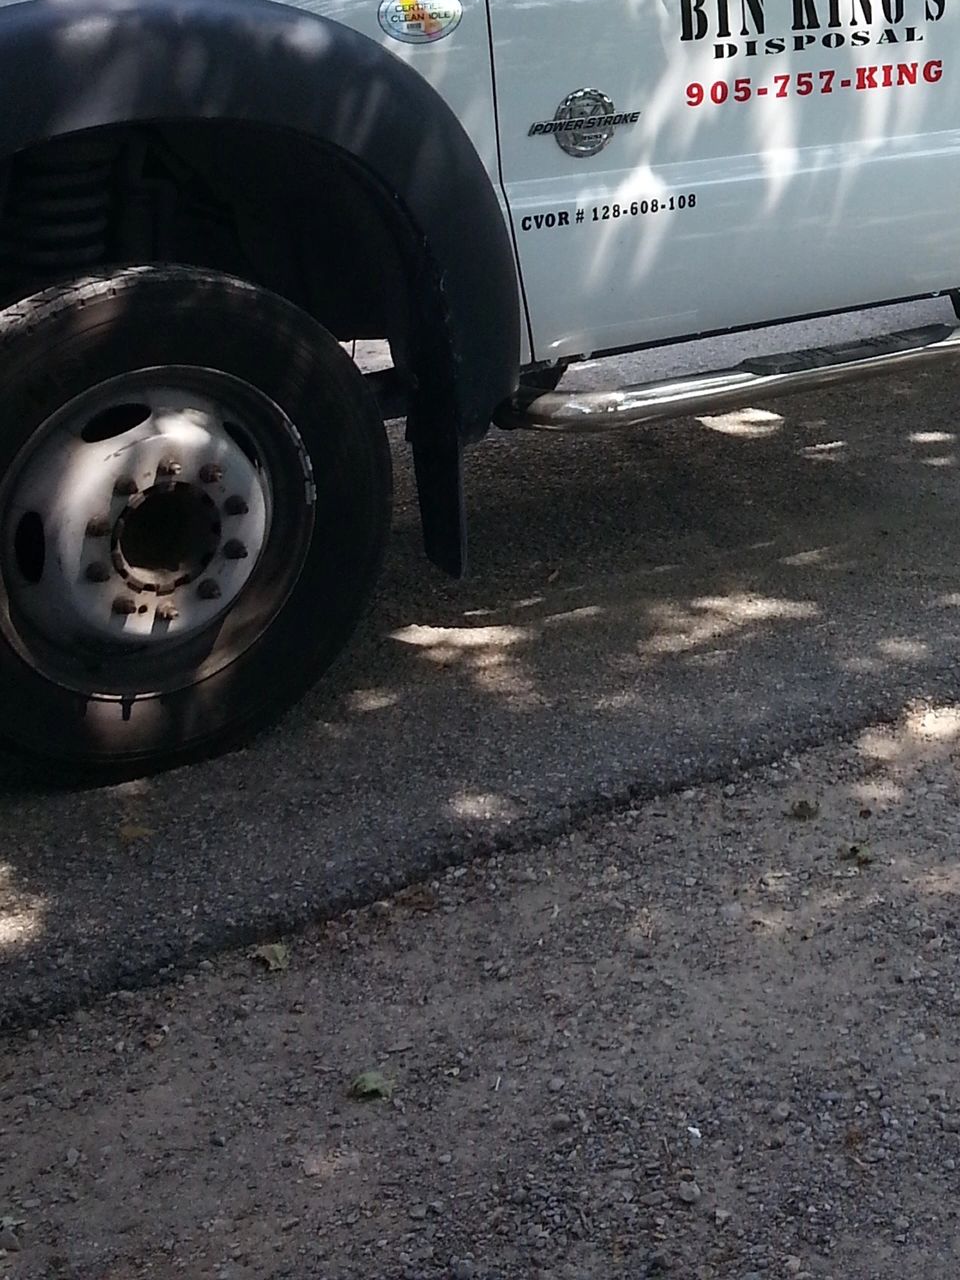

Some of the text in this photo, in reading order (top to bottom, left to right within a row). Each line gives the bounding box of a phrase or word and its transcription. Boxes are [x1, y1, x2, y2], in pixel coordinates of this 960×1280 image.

[391, 11, 425, 23] CLEAN
[713, 26, 924, 59] DISPOSAL
[686, 60, 943, 107] 905-757-KING
[521, 194, 697, 231] CVOR # 128-608-108
